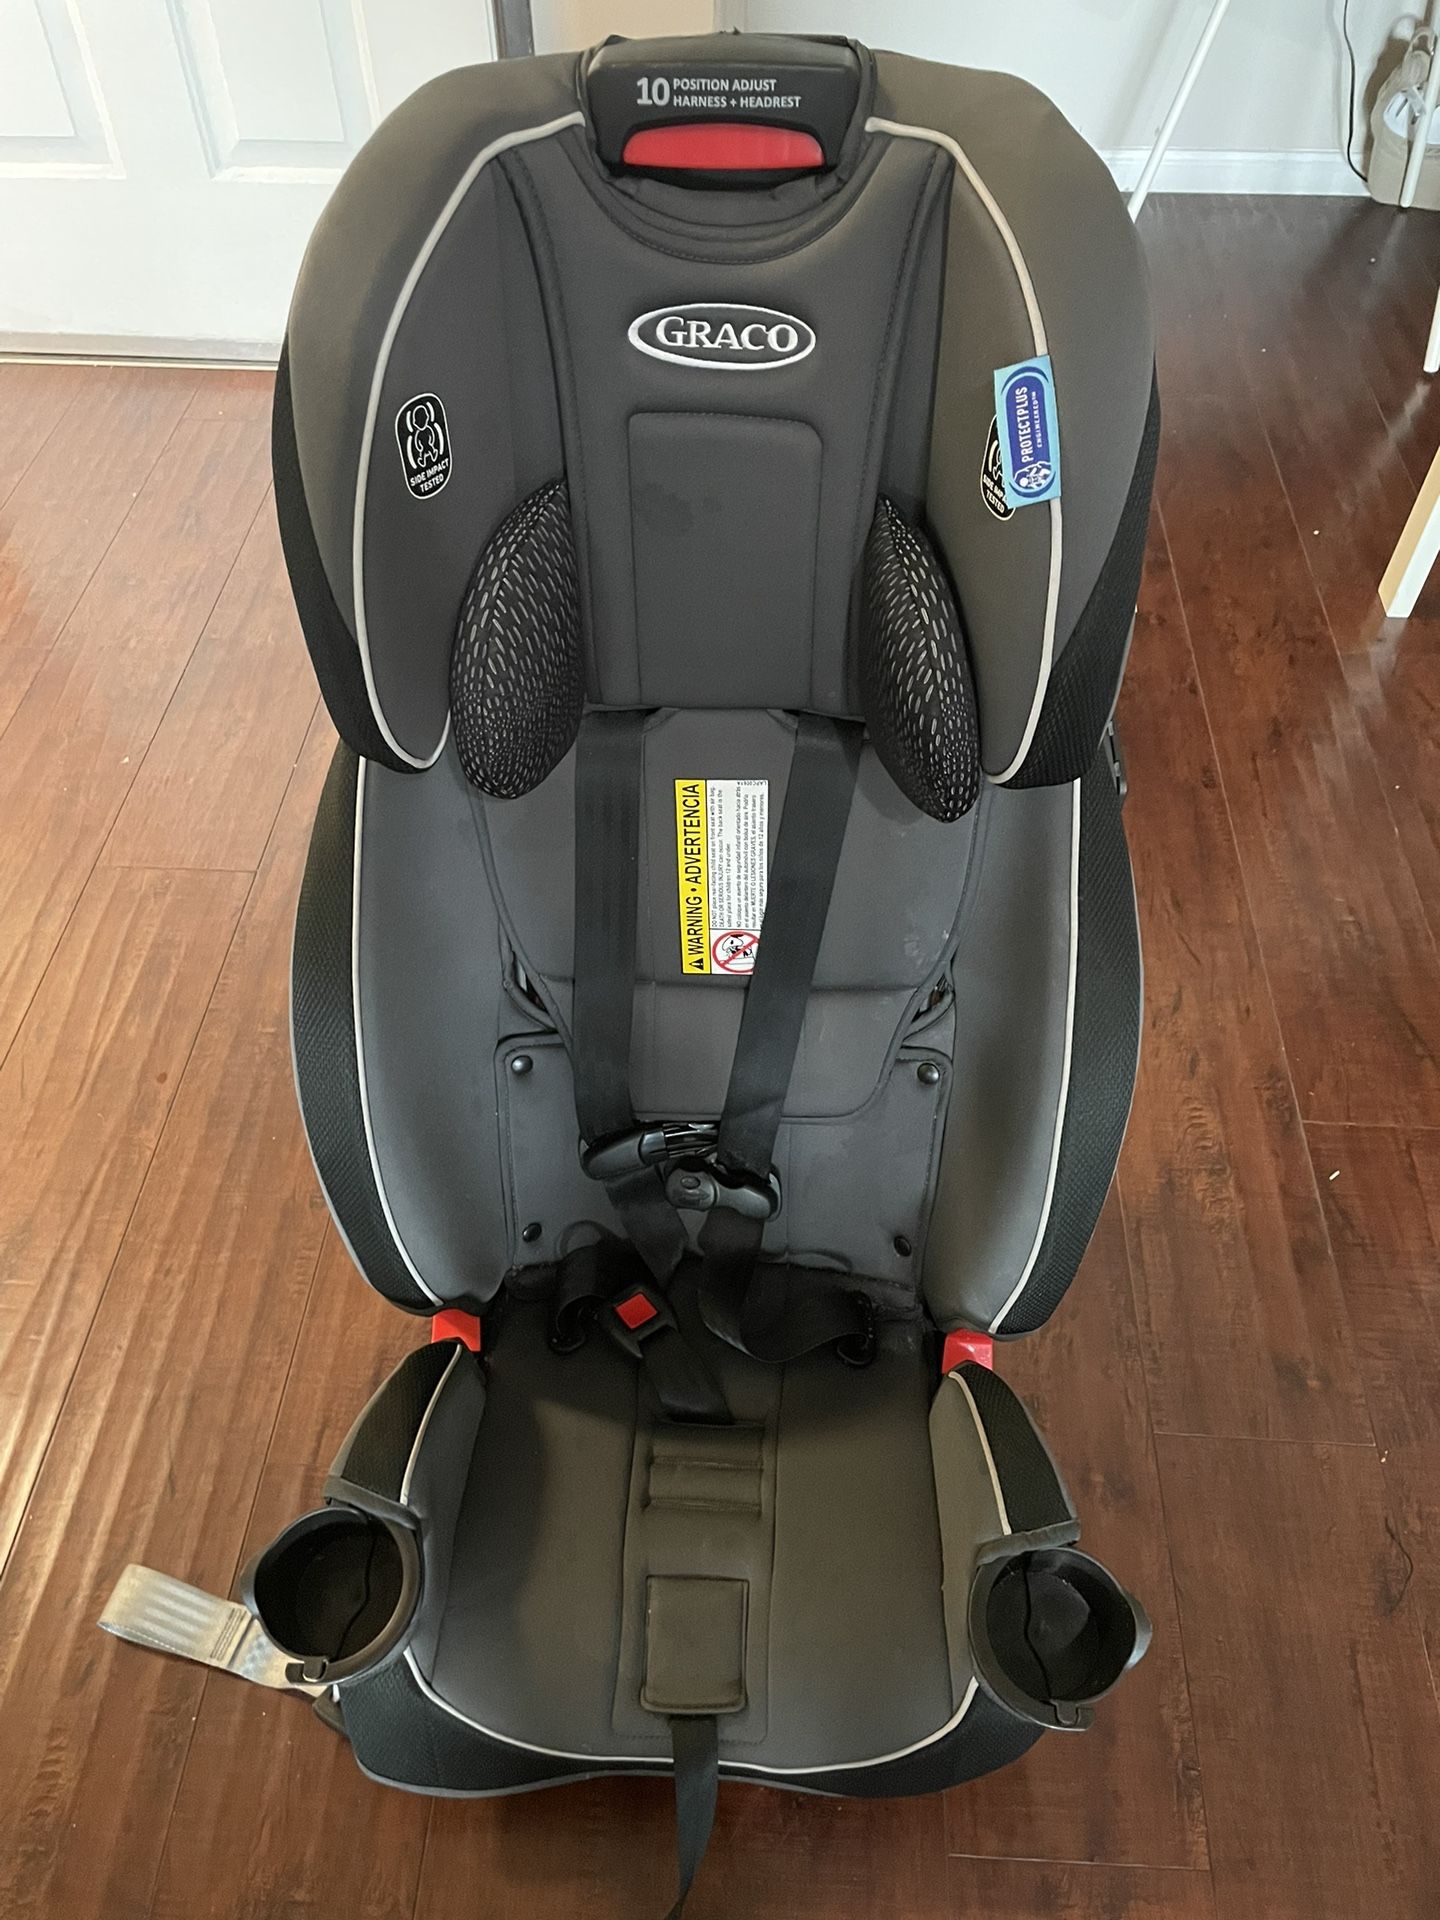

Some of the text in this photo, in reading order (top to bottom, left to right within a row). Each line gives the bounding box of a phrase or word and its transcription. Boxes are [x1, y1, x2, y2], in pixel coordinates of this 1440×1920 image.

[636, 77, 671, 106] 10
[673, 78, 777, 91] POSITION ADJUST
[673, 95, 802, 108] HARNESS + HEADREST
[656, 316, 798, 352] GRACO
[1015, 386, 1034, 463] PROTECTPLUS
[410, 458, 449, 487] SIDE IMPACT
[420, 473, 444, 492] TESTED
[983, 474, 994, 491] SIDE
[986, 489, 1005, 514] TESTED
[682, 784, 704, 956] WARNING ADVERTENCIA
